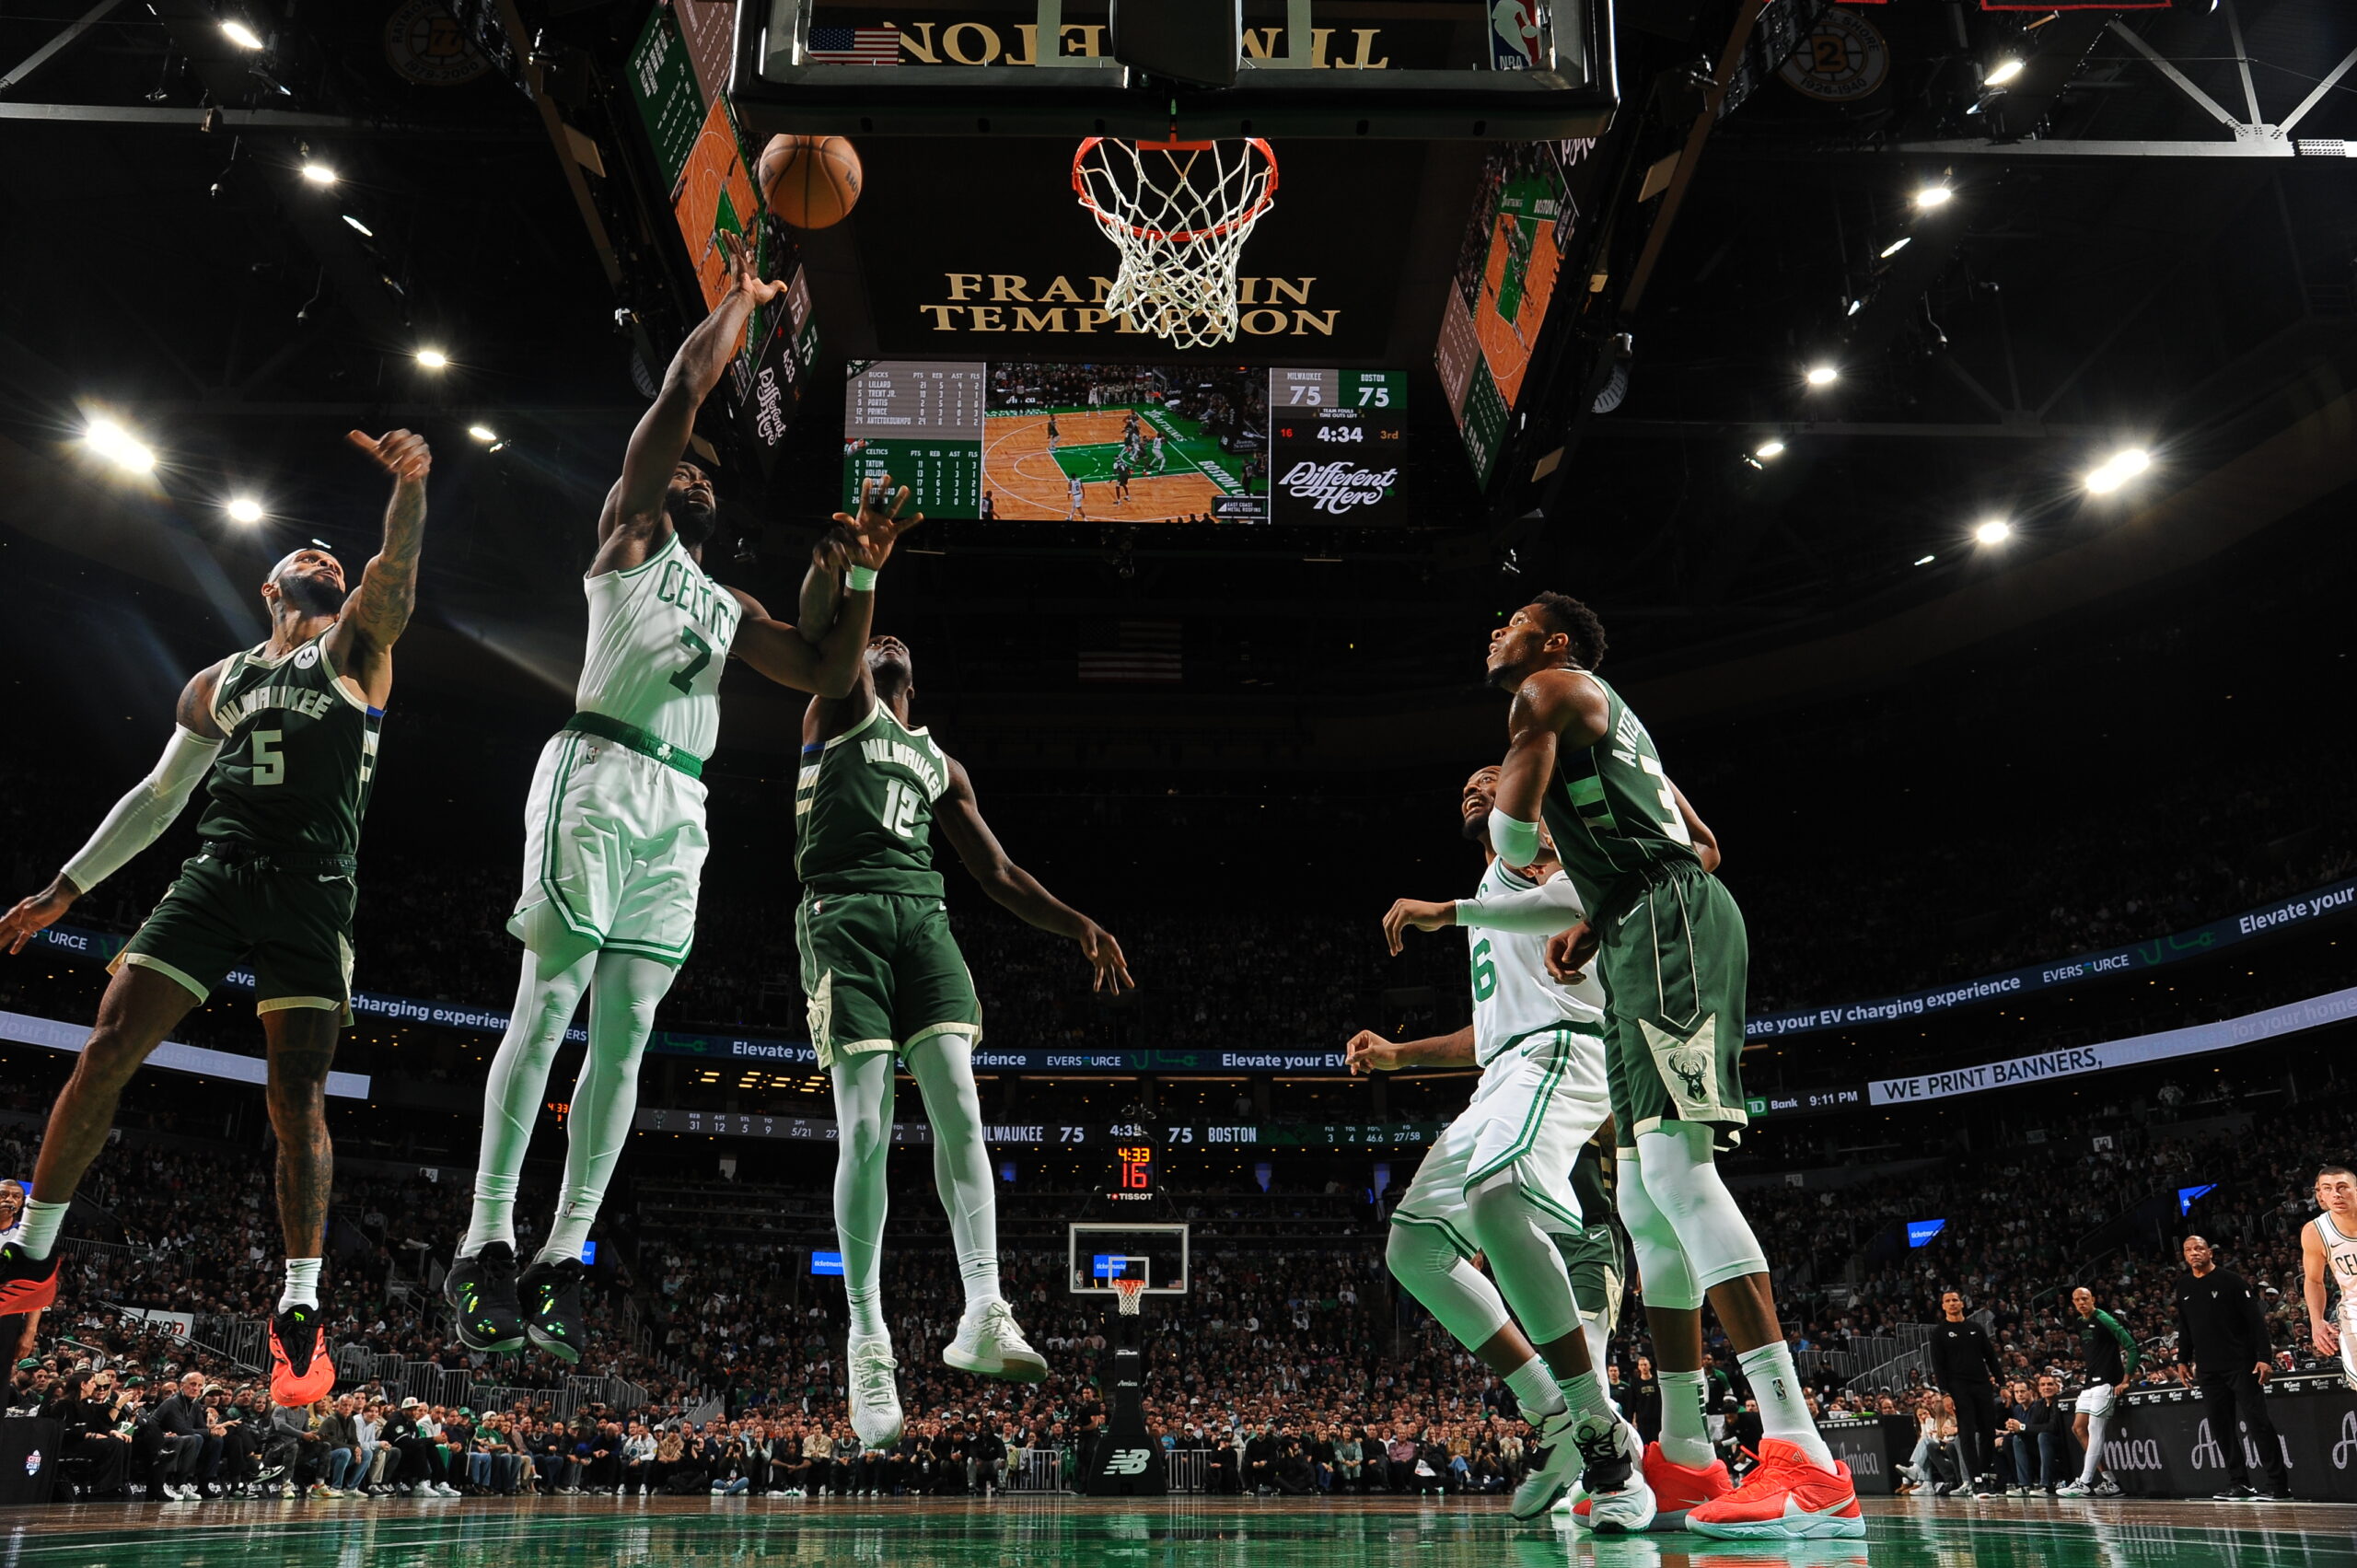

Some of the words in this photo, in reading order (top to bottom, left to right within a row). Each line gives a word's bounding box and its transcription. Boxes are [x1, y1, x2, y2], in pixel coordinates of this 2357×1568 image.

[1841, 17, 1879, 52] SHORE
[1499, 55, 1524, 70] NBA
[1817, 41, 1841, 65] 2
[791, 293, 804, 325] 75
[802, 335, 814, 366] 75
[1287, 372, 1322, 381] MILWAUKEE
[1361, 374, 1385, 382] BOSTON
[1290, 386, 1321, 406] 75
[1358, 388, 1389, 407] 75
[1281, 428, 1293, 438] 16
[1317, 426, 1364, 443] 4:34
[1380, 431, 1399, 439] 3rd
[1198, 460, 1242, 488] BOSTON
[1278, 461, 1399, 493] Different
[1291, 485, 1384, 515] Here
[668, 625, 713, 696] 7
[215, 686, 334, 738] MILWAUKEE
[251, 729, 284, 785] 5
[882, 779, 922, 838] 12
[2239, 902, 2308, 935] Elevate
[2310, 886, 2355, 917] your
[2043, 954, 2130, 983] EVERSOURCE
[349, 993, 430, 1020] charging
[433, 1007, 510, 1032] experien
[1777, 1014, 1817, 1034] your
[1819, 1008, 1843, 1025] EV
[1846, 997, 1924, 1021] charging
[1926, 976, 2021, 1007] experience
[2231, 1020, 2256, 1040] for
[2260, 1009, 2300, 1036] your
[733, 1041, 794, 1059] Elevate
[970, 1051, 1027, 1066] erience
[1046, 1056, 1121, 1066] EVERSOURCE
[1222, 1053, 1281, 1067] Elevate
[1284, 1055, 1321, 1069] your
[1325, 1054, 1346, 1067] EV
[1884, 1079, 1920, 1100] WE
[1928, 1067, 1987, 1095] PRINT
[1993, 1047, 2104, 1085] BANNERS,
[547, 1102, 569, 1114] 4:33
[1747, 1100, 1766, 1113] TD
[1771, 1098, 1798, 1110] Bank
[1809, 1093, 1835, 1107] 9:11
[1839, 1090, 1858, 1103] PM
[690, 1121, 700, 1131] 31
[714, 1122, 726, 1132] 12
[742, 1124, 749, 1133] 5
[765, 1125, 772, 1134] 9
[791, 1128, 811, 1137] 5/21
[895, 1132, 902, 1141] 4
[921, 1132, 924, 1141] 1
[983, 1126, 1043, 1142] ILWAUKEE
[1060, 1127, 1085, 1143] 75
[1109, 1125, 1137, 1137] 4:3
[1168, 1127, 1193, 1143] 75
[1208, 1126, 1256, 1142] BOSTON
[1328, 1134, 1333, 1143] 3
[1348, 1133, 1354, 1142] 4
[1365, 1133, 1383, 1143] 46.6
[1394, 1132, 1421, 1142] 27/58
[1118, 1148, 1150, 1162] 4:33
[1122, 1163, 1147, 1188] 16
[2103, 1427, 2162, 1470] mica
[1840, 1443, 1879, 1475] Amica
